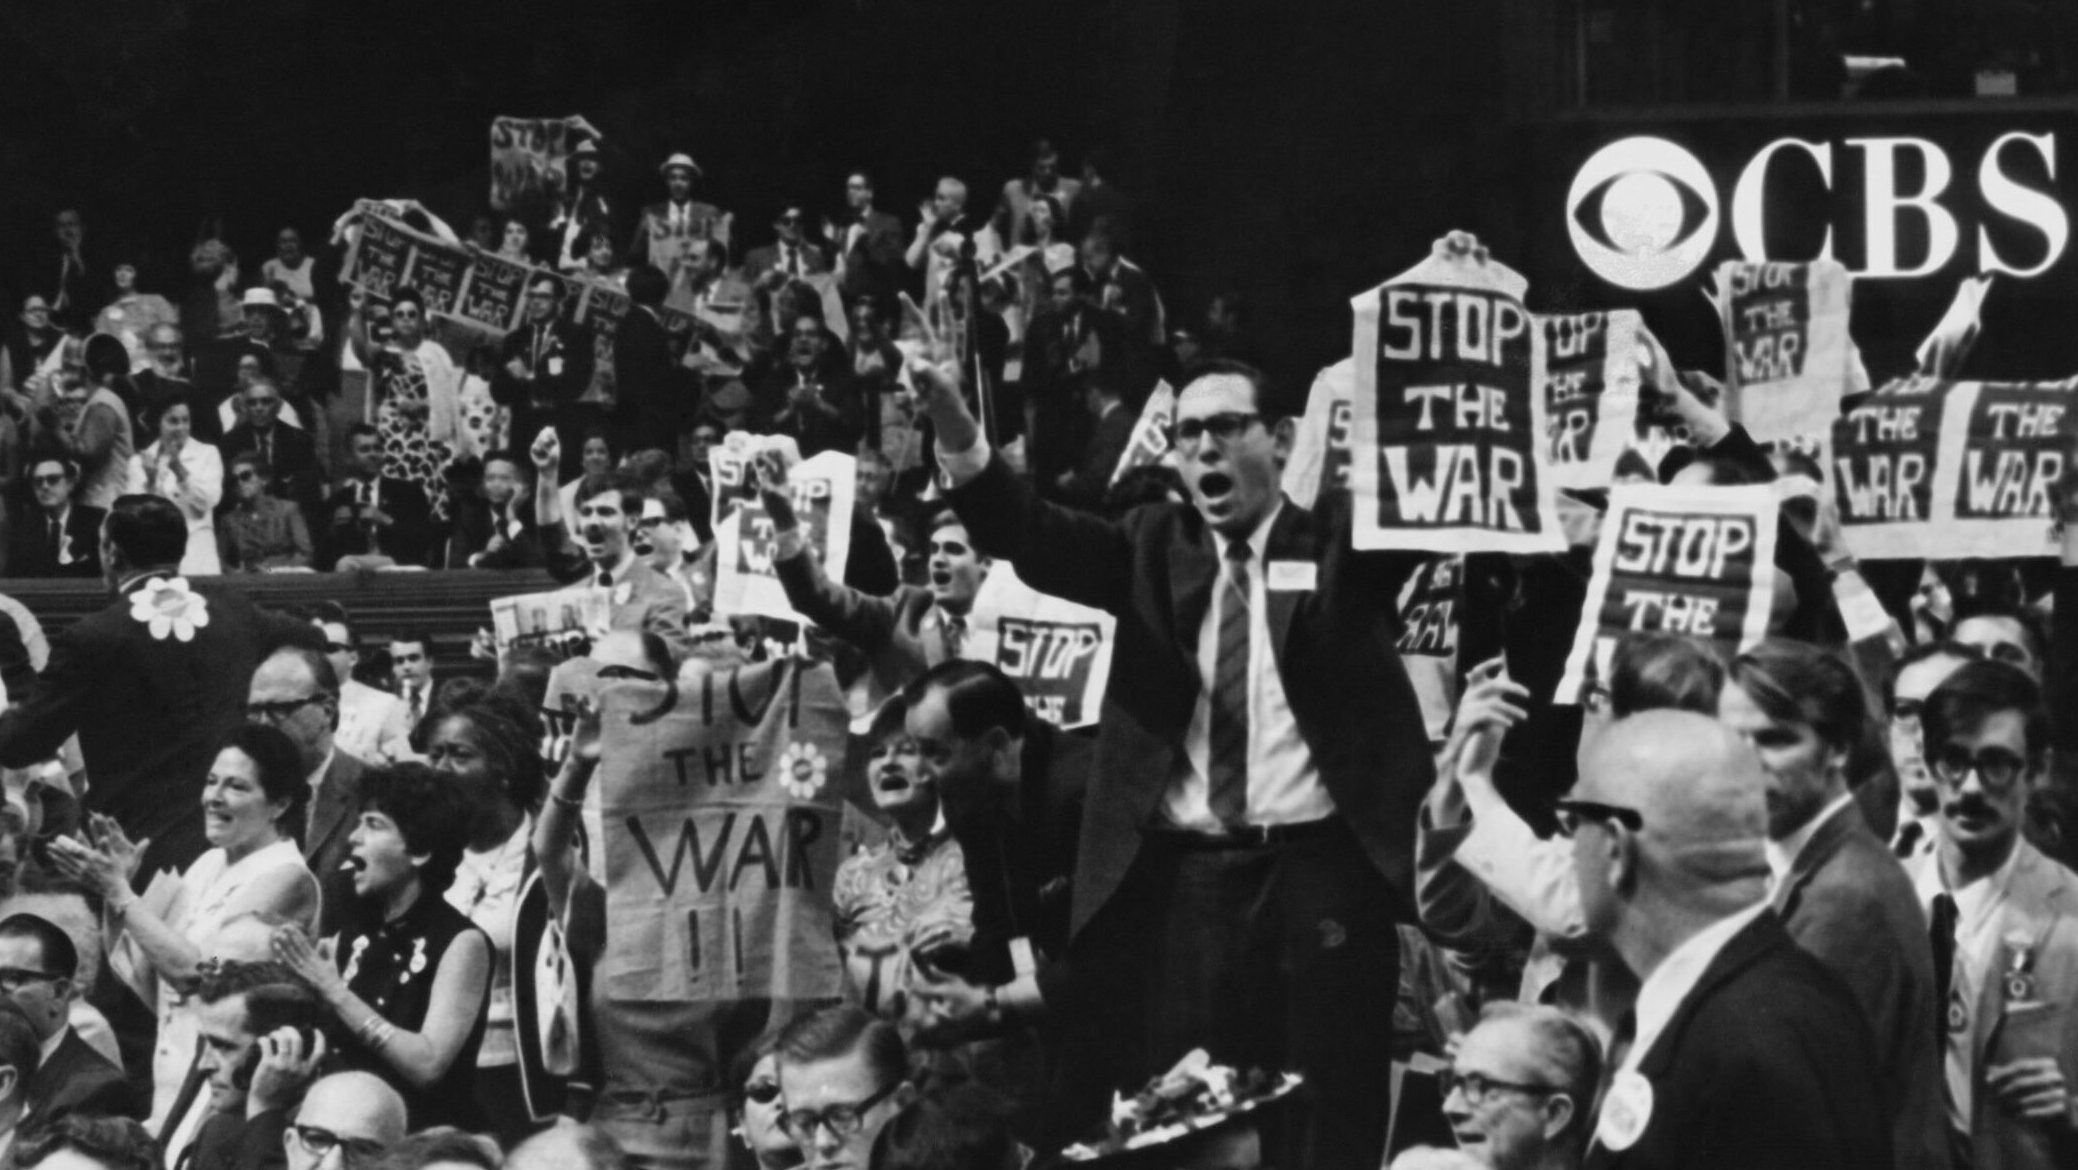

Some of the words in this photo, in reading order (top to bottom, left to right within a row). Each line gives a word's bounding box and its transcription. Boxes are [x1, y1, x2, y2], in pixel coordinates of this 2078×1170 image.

[1732, 131, 2069, 278] CBS
[1384, 290, 1526, 366] STOP
[1744, 301, 1795, 332] THE
[1733, 333, 1799, 380] WAR
[1404, 383, 1511, 431] THE
[1848, 405, 1921, 443] THE
[1988, 402, 2066, 439] THE
[1383, 443, 1527, 532] WAR
[1838, 454, 1925, 518] WAR
[1967, 450, 2064, 513] WAR
[1616, 513, 1750, 578] STOP
[1623, 590, 1720, 635] THE
[1000, 622, 1098, 680] STOP
[663, 742, 764, 786] THE
[626, 806, 823, 897] WAR
